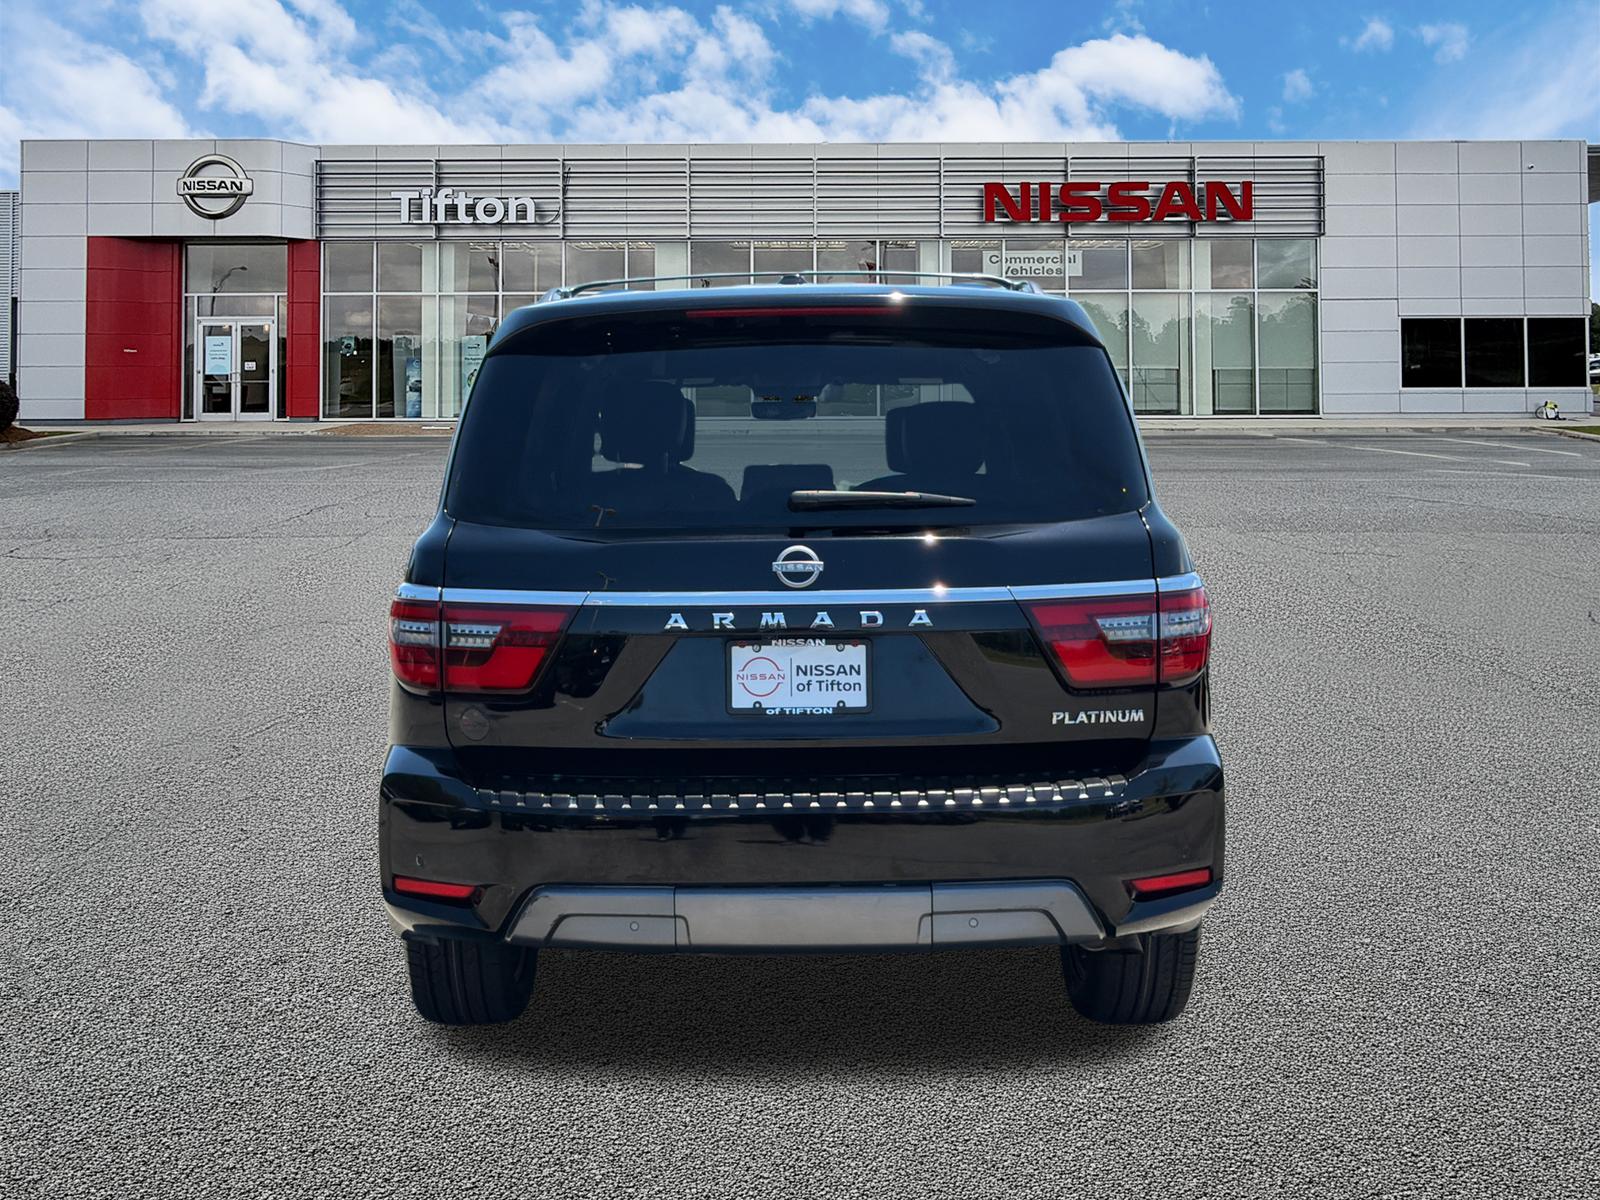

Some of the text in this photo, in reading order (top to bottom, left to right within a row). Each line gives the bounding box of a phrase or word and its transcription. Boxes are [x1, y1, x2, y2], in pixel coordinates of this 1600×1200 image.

[182, 180, 243, 191] NISSAN
[391, 187, 536, 224] Tifton
[983, 181, 1254, 223] NISSAN
[773, 563, 824, 572] NISSAN
[664, 609, 934, 630] ARMADA
[771, 638, 826, 647] NISSAN
[796, 664, 862, 676] NISSAN
[796, 680, 862, 692] of Tifton
[766, 707, 833, 715] of TIFTON
[1051, 708, 1145, 725] PLATINUM
